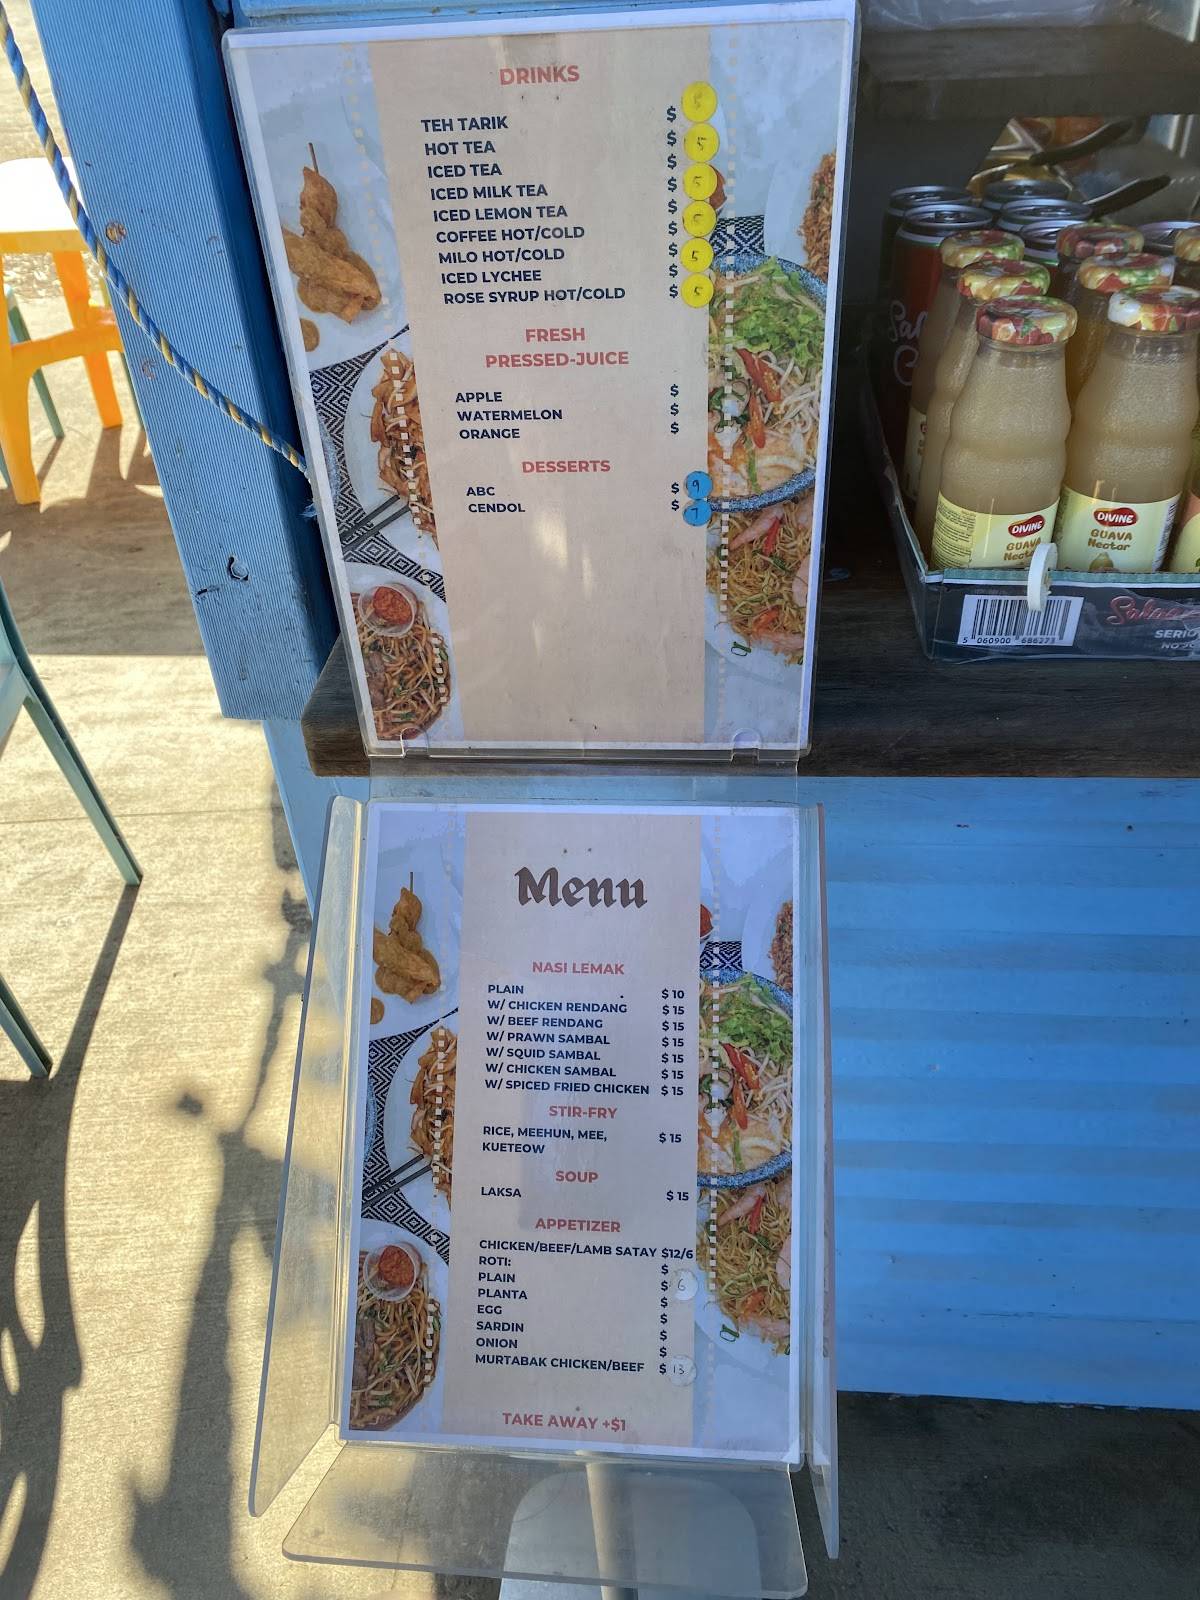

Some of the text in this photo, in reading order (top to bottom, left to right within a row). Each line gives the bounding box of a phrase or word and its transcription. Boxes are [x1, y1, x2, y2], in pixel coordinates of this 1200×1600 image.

[500, 65, 580, 85] DRINKS
[421, 105, 677, 132] TEH TARIK $
[425, 130, 677, 156] HOT TEA $
[428, 153, 677, 178] ICED TEA $
[431, 176, 677, 200] ICED MILK TEA $
[433, 198, 677, 222] ICED LEMON TEA $
[436, 221, 678, 243] COFFEE HOT/COLD $
[439, 242, 678, 264] MILO HOT/COLD $
[441, 263, 678, 285] ICED LYCHEE $
[443, 284, 678, 305] ROSE SYRUP HOT/COLD $
[525, 327, 585, 343] FRESH
[485, 351, 629, 368] PRESSED-JUICE
[455, 384, 679, 403] APPLE $
[457, 403, 679, 422] WATERMELON $
[459, 421, 679, 440] ORANGE $
[522, 460, 611, 474] DESSERTS
[466, 482, 679, 497] ABC $
[468, 499, 679, 513] CENDOL $
[1011, 520, 1043, 534] DIVINE
[1097, 512, 1134, 524] DIVINE
[1090, 529, 1133, 541] GUAVA
[1087, 538, 1131, 551] Nectar
[1154, 627, 1200, 638] SERIO
[514, 866, 648, 909] Menu
[532, 961, 625, 975] NASI LEMAK
[487, 984, 685, 1001] PLAIN $ 10
[487, 999, 684, 1016] W/ CHICKEN RENDANG $ 15
[487, 1015, 684, 1032] W/ BEEF RENDANG $ 15
[486, 1030, 684, 1048] W/ PRAWN SAMBAL $ 15
[486, 1046, 684, 1064] W/ SQUID SAMBAL $ 15
[485, 1062, 684, 1080] W/ CHICKEN SAMBAL $ 15
[485, 1078, 684, 1096] W/ SPICED FRIED CHICKEN $ 15
[549, 1105, 618, 1119] STIR-FRY
[483, 1126, 682, 1144] RICE, MEEHUN, MEE, $ 15
[482, 1142, 545, 1154] KUETEOW
[555, 1170, 599, 1183] SOUP
[481, 1187, 689, 1202] LAKSA $ 15
[535, 1218, 621, 1233] APPETIZER
[479, 1239, 694, 1261] CHICKEN/BEEF/LAMB SATAY $12/6
[478, 1256, 669, 1275] ROTI: $
[478, 1272, 668, 1292] PLAIN $
[477, 1288, 668, 1308] PLANTA $
[477, 1304, 668, 1325] EGG $
[476, 1321, 667, 1341] SARDIN $
[476, 1337, 667, 1358] ONION $
[475, 1354, 667, 1375] MURTABAK CHICKEN/BEEF $
[502, 1412, 627, 1433] TAKE AWAY +$1
